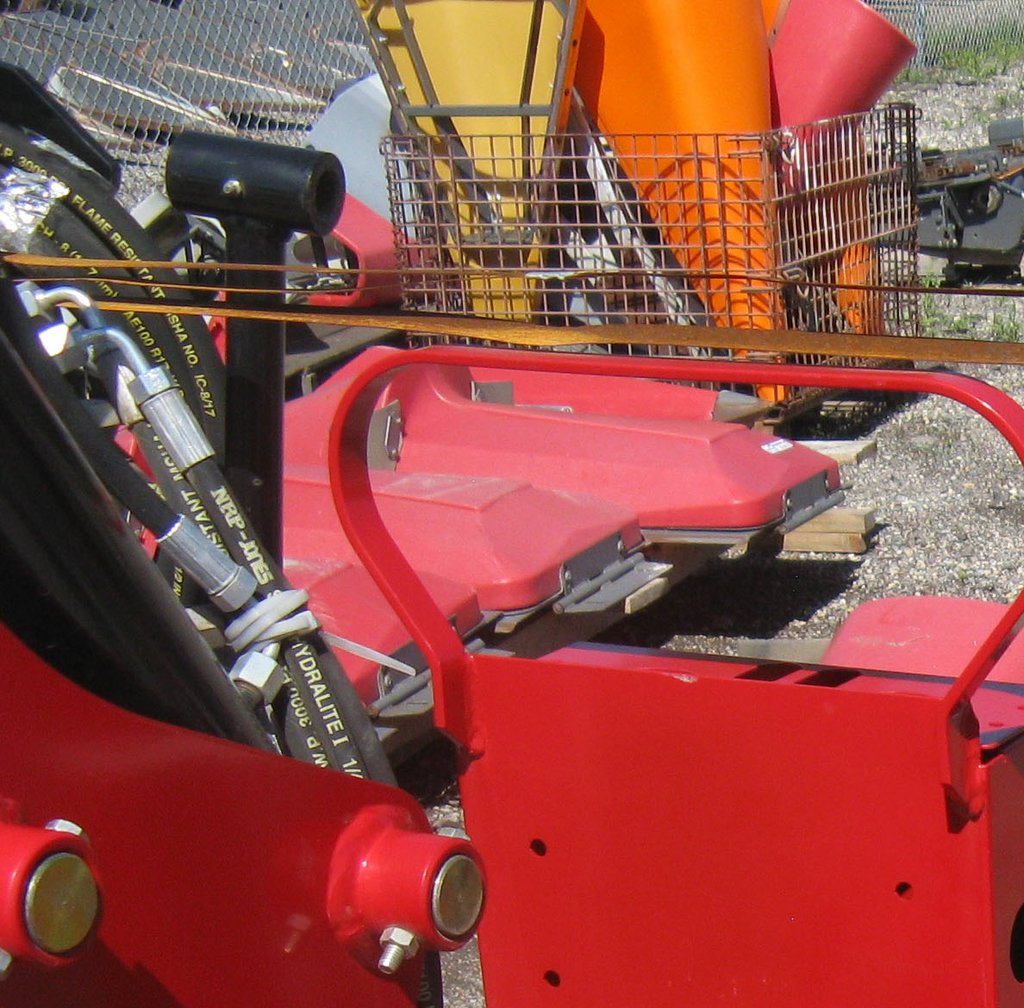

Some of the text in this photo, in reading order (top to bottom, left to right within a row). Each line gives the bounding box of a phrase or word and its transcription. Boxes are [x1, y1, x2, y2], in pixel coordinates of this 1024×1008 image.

[72, 195, 113, 235] FLAME
[166, 313, 216, 418] SHA NO. IC-8/17
